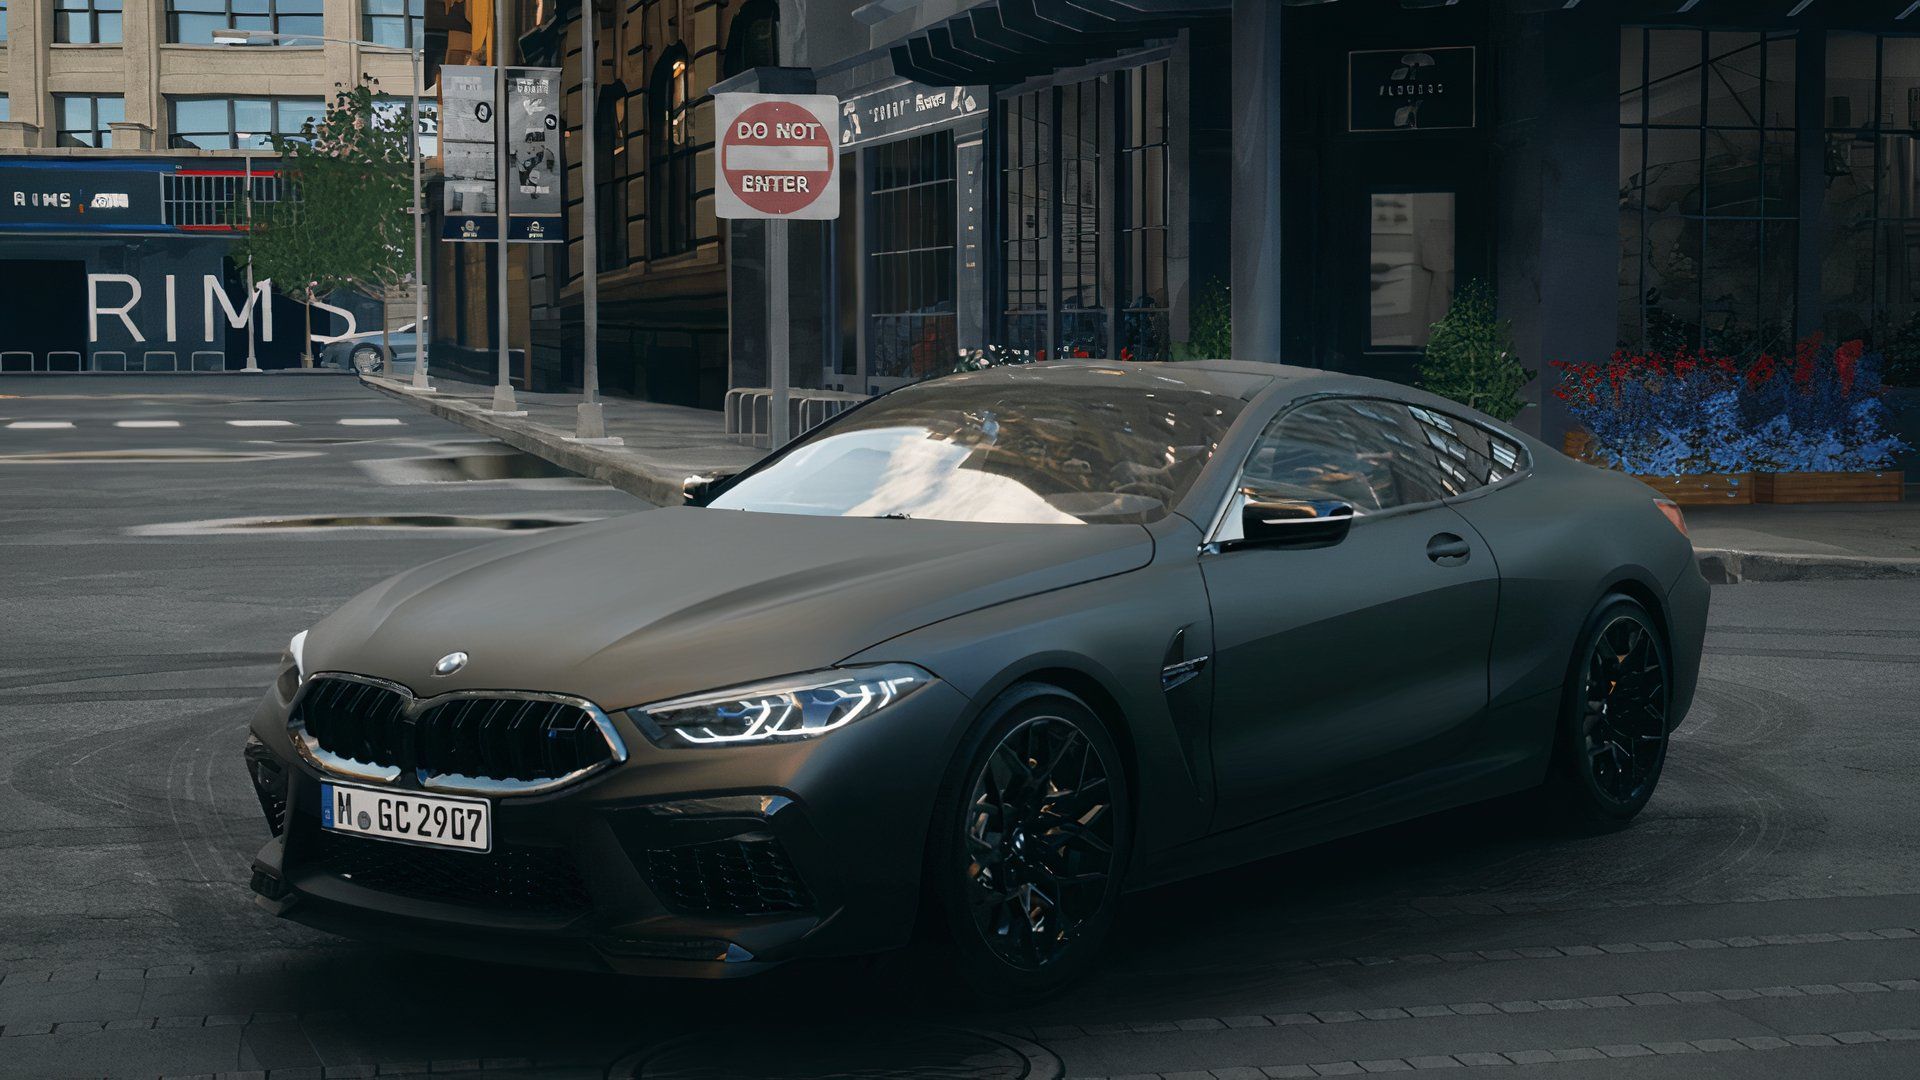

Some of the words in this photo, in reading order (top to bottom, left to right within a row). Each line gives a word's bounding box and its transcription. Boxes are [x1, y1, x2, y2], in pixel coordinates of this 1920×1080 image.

[737, 122, 768, 139] DO
[776, 122, 821, 140] NOT
[742, 175, 809, 193] ENTER
